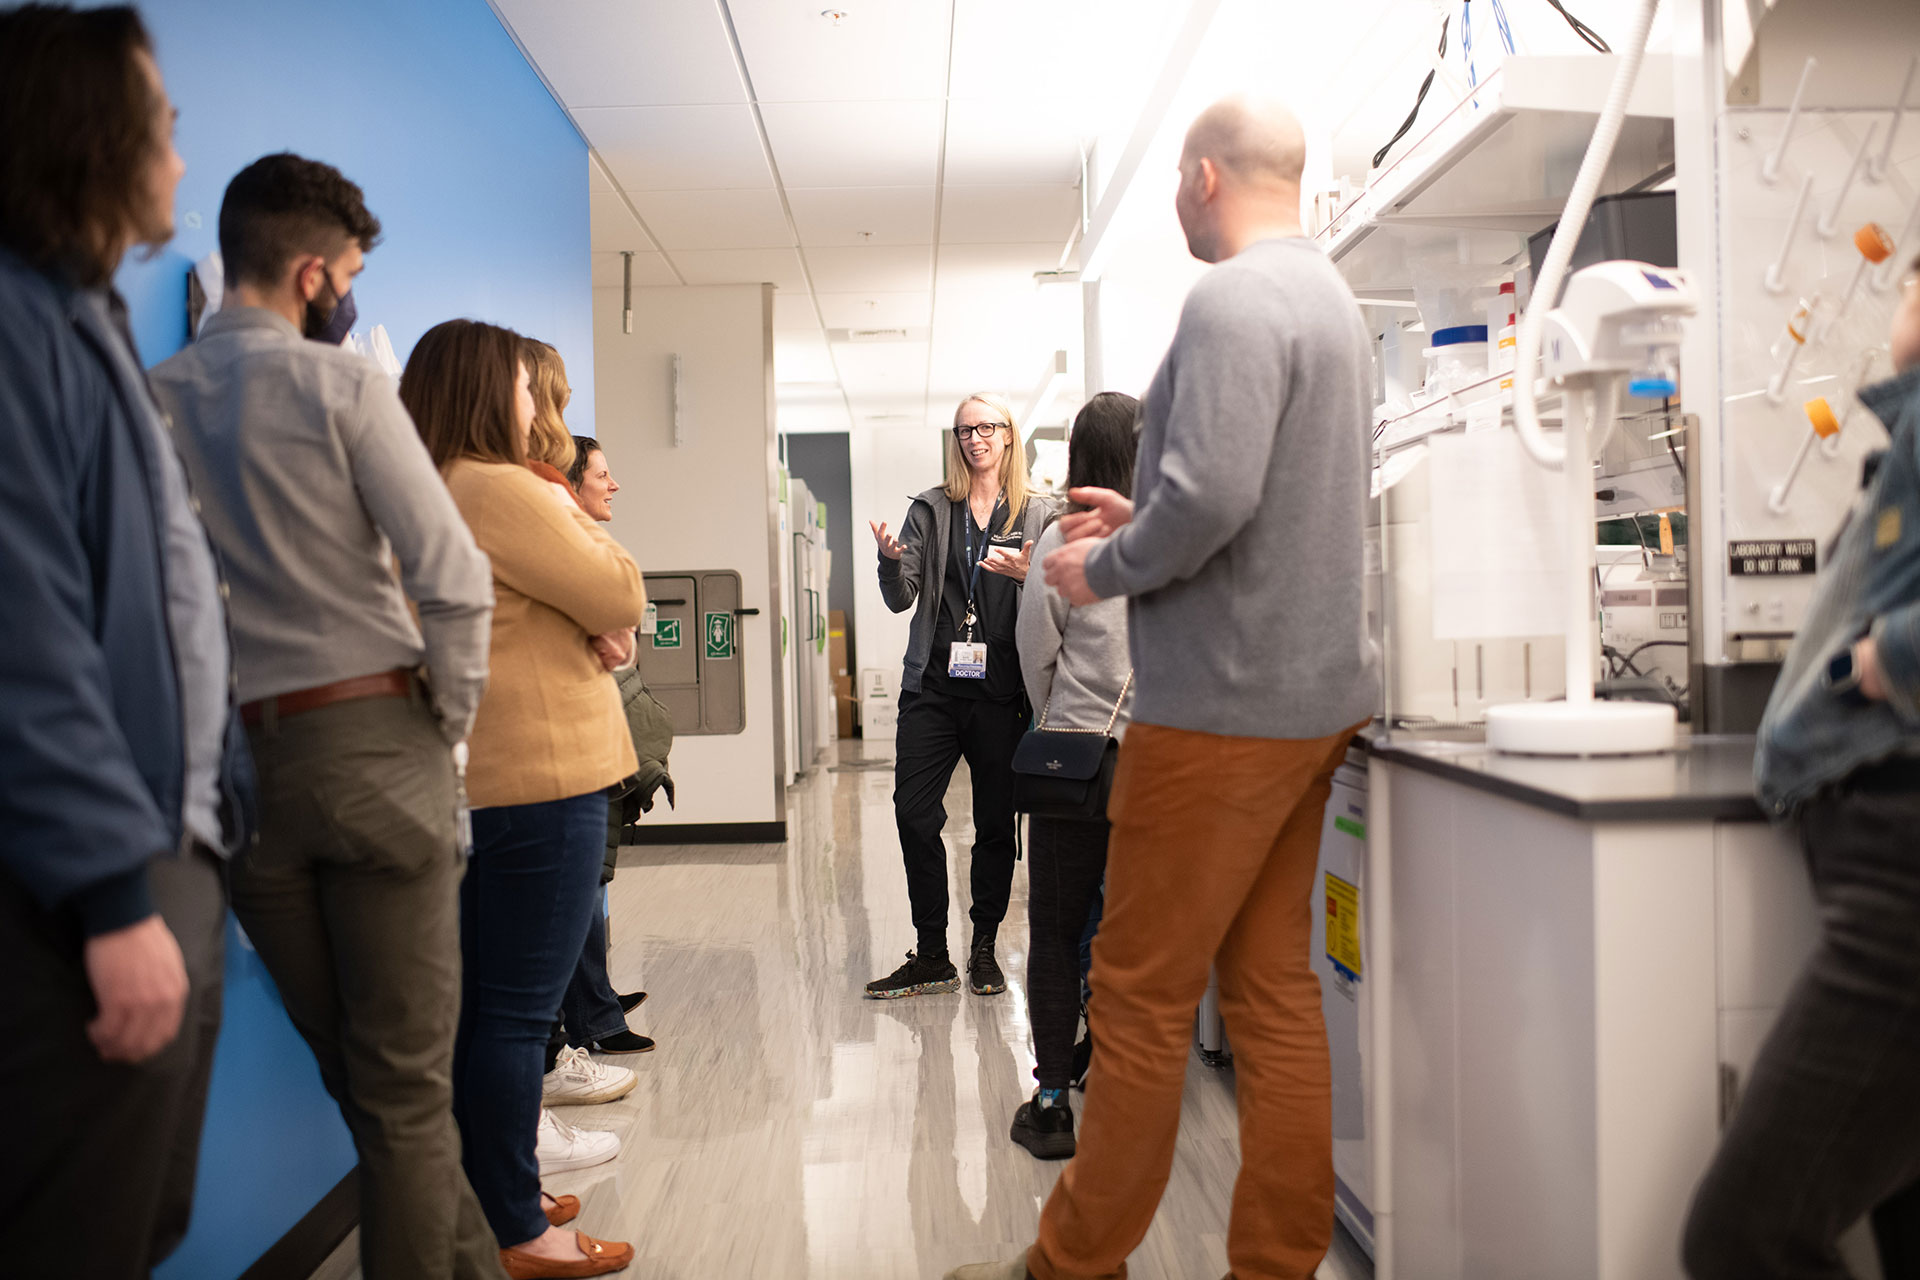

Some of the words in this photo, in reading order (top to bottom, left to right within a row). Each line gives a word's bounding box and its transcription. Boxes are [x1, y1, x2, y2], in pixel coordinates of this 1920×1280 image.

[1730, 543, 1781, 556] LABORATORY
[1785, 543, 1813, 555] WATER
[1743, 560, 1755, 572] DO
[1758, 559, 1773, 572] NOT
[1777, 559, 1800, 571] DRINK
